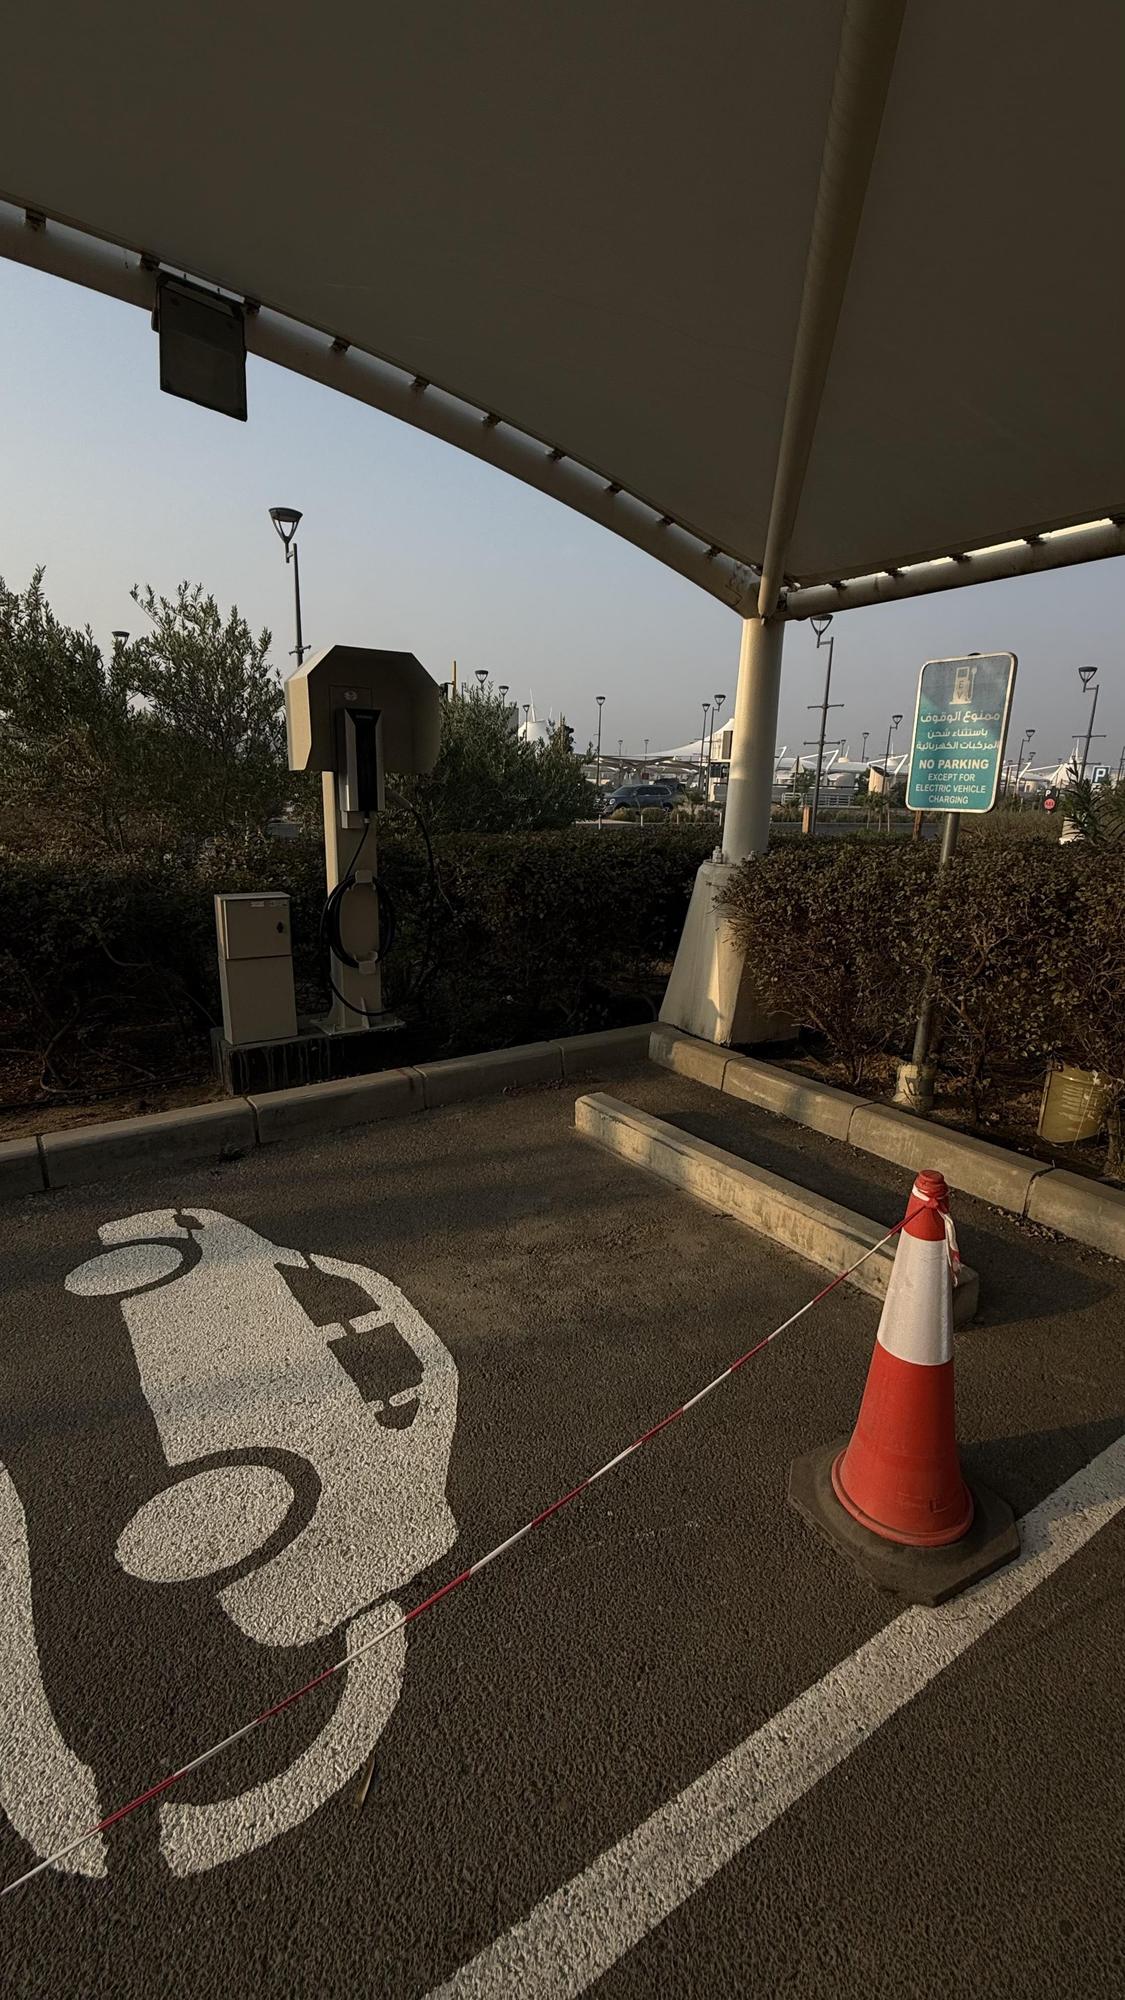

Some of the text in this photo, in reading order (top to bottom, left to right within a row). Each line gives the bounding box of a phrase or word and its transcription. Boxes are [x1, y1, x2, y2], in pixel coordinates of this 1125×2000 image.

[920, 710, 1000, 724] ممنوع الوقوف
[928, 728, 988, 739] باستثناء شحن
[916, 741, 958, 751] الكهربائية
[919, 760, 989, 770] NO PARKING
[928, 773, 976, 782] EXCEPT FOR
[1094, 768, 1106, 782] P
[916, 784, 986, 794] ELECTRIC VEHICLE
[928, 796, 969, 804] CHARGING
